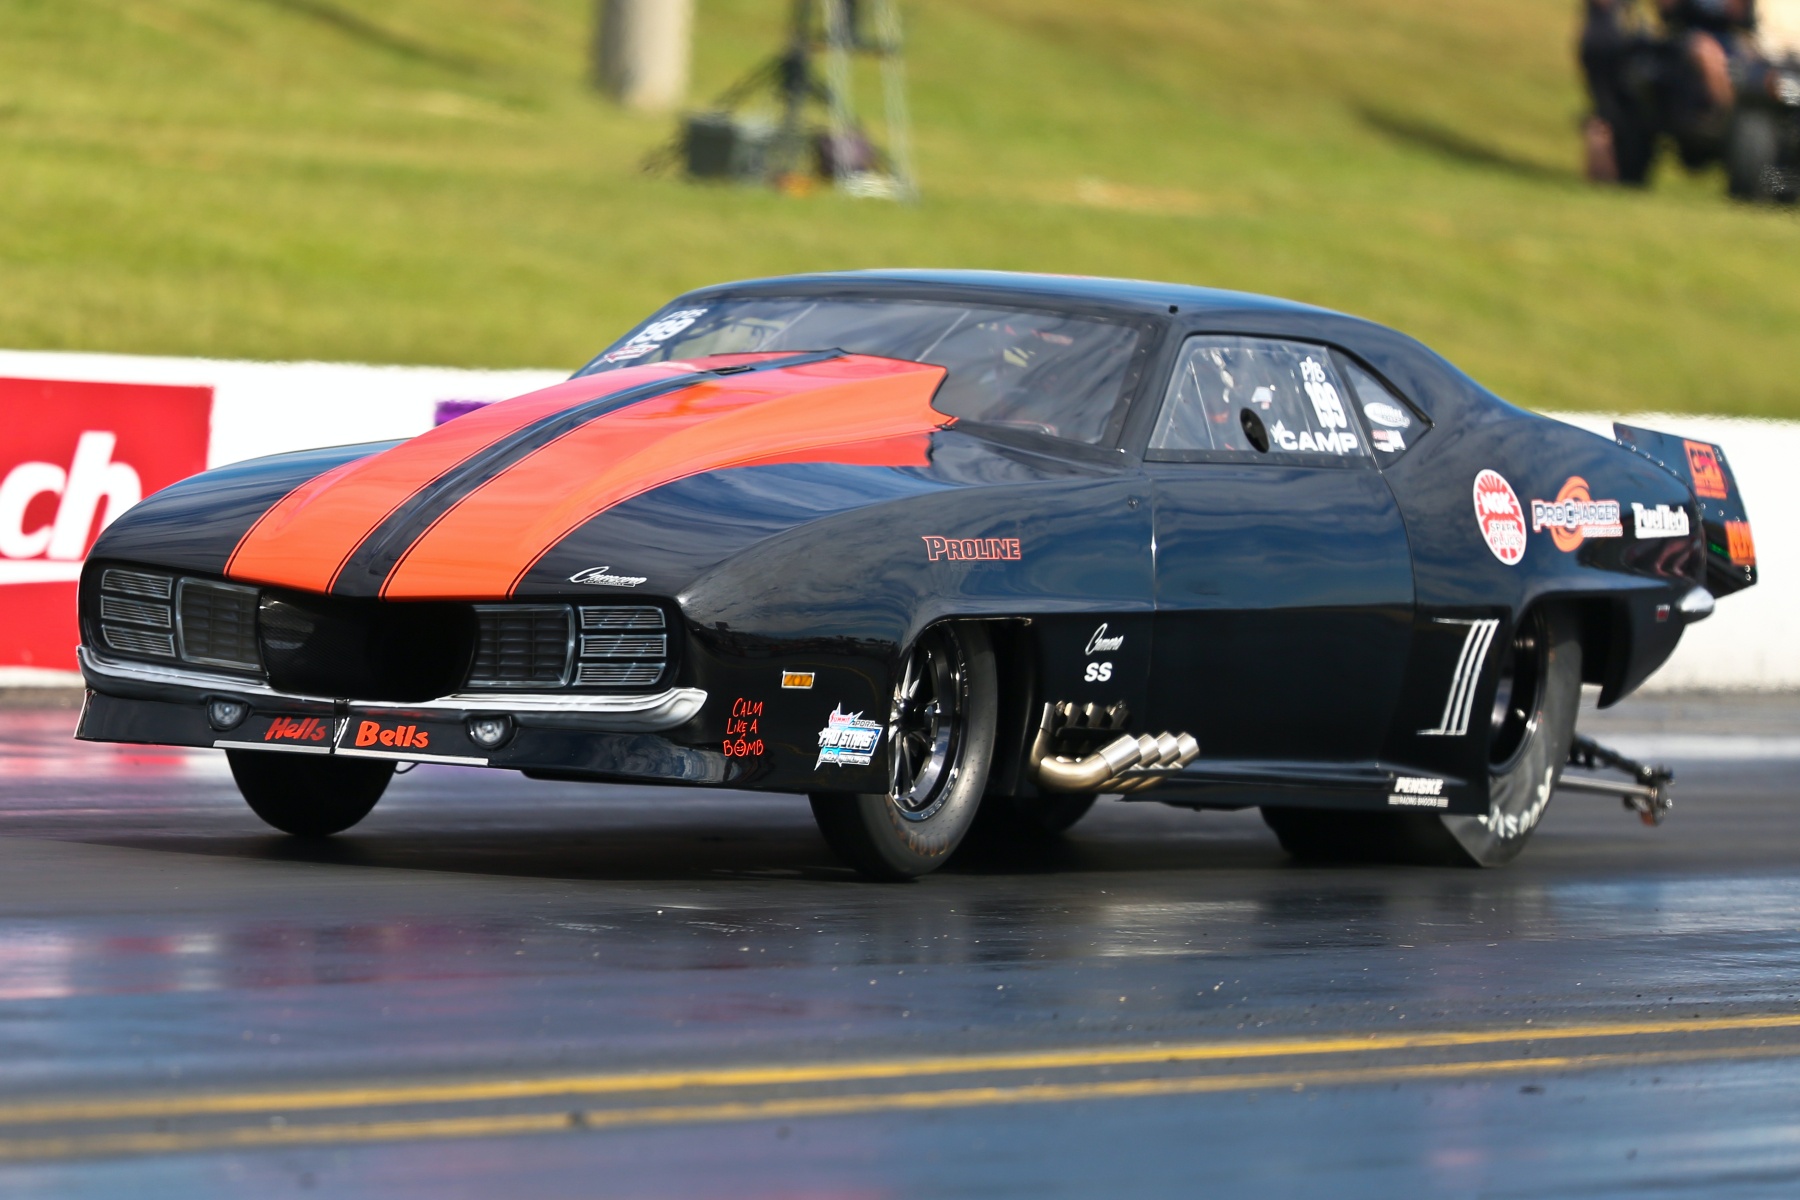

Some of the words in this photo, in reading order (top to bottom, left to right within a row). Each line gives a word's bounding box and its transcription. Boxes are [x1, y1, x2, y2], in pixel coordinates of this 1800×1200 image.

[1304, 381, 1347, 429] 199
[1280, 430, 1358, 454] CAMP
[1480, 491, 1515, 515] NGK
[1489, 521, 1517, 533] SPARK
[921, 535, 1022, 561] PROLINE
[1493, 536, 1520, 546] PLUGS
[1084, 661, 1113, 682] SS
[732, 697, 763, 717] CALM
[264, 716, 327, 741] Hells
[355, 720, 429, 748] Bells
[726, 717, 748, 735] LIKE
[750, 718, 757, 734] A
[1394, 776, 1444, 796] PENSKE
